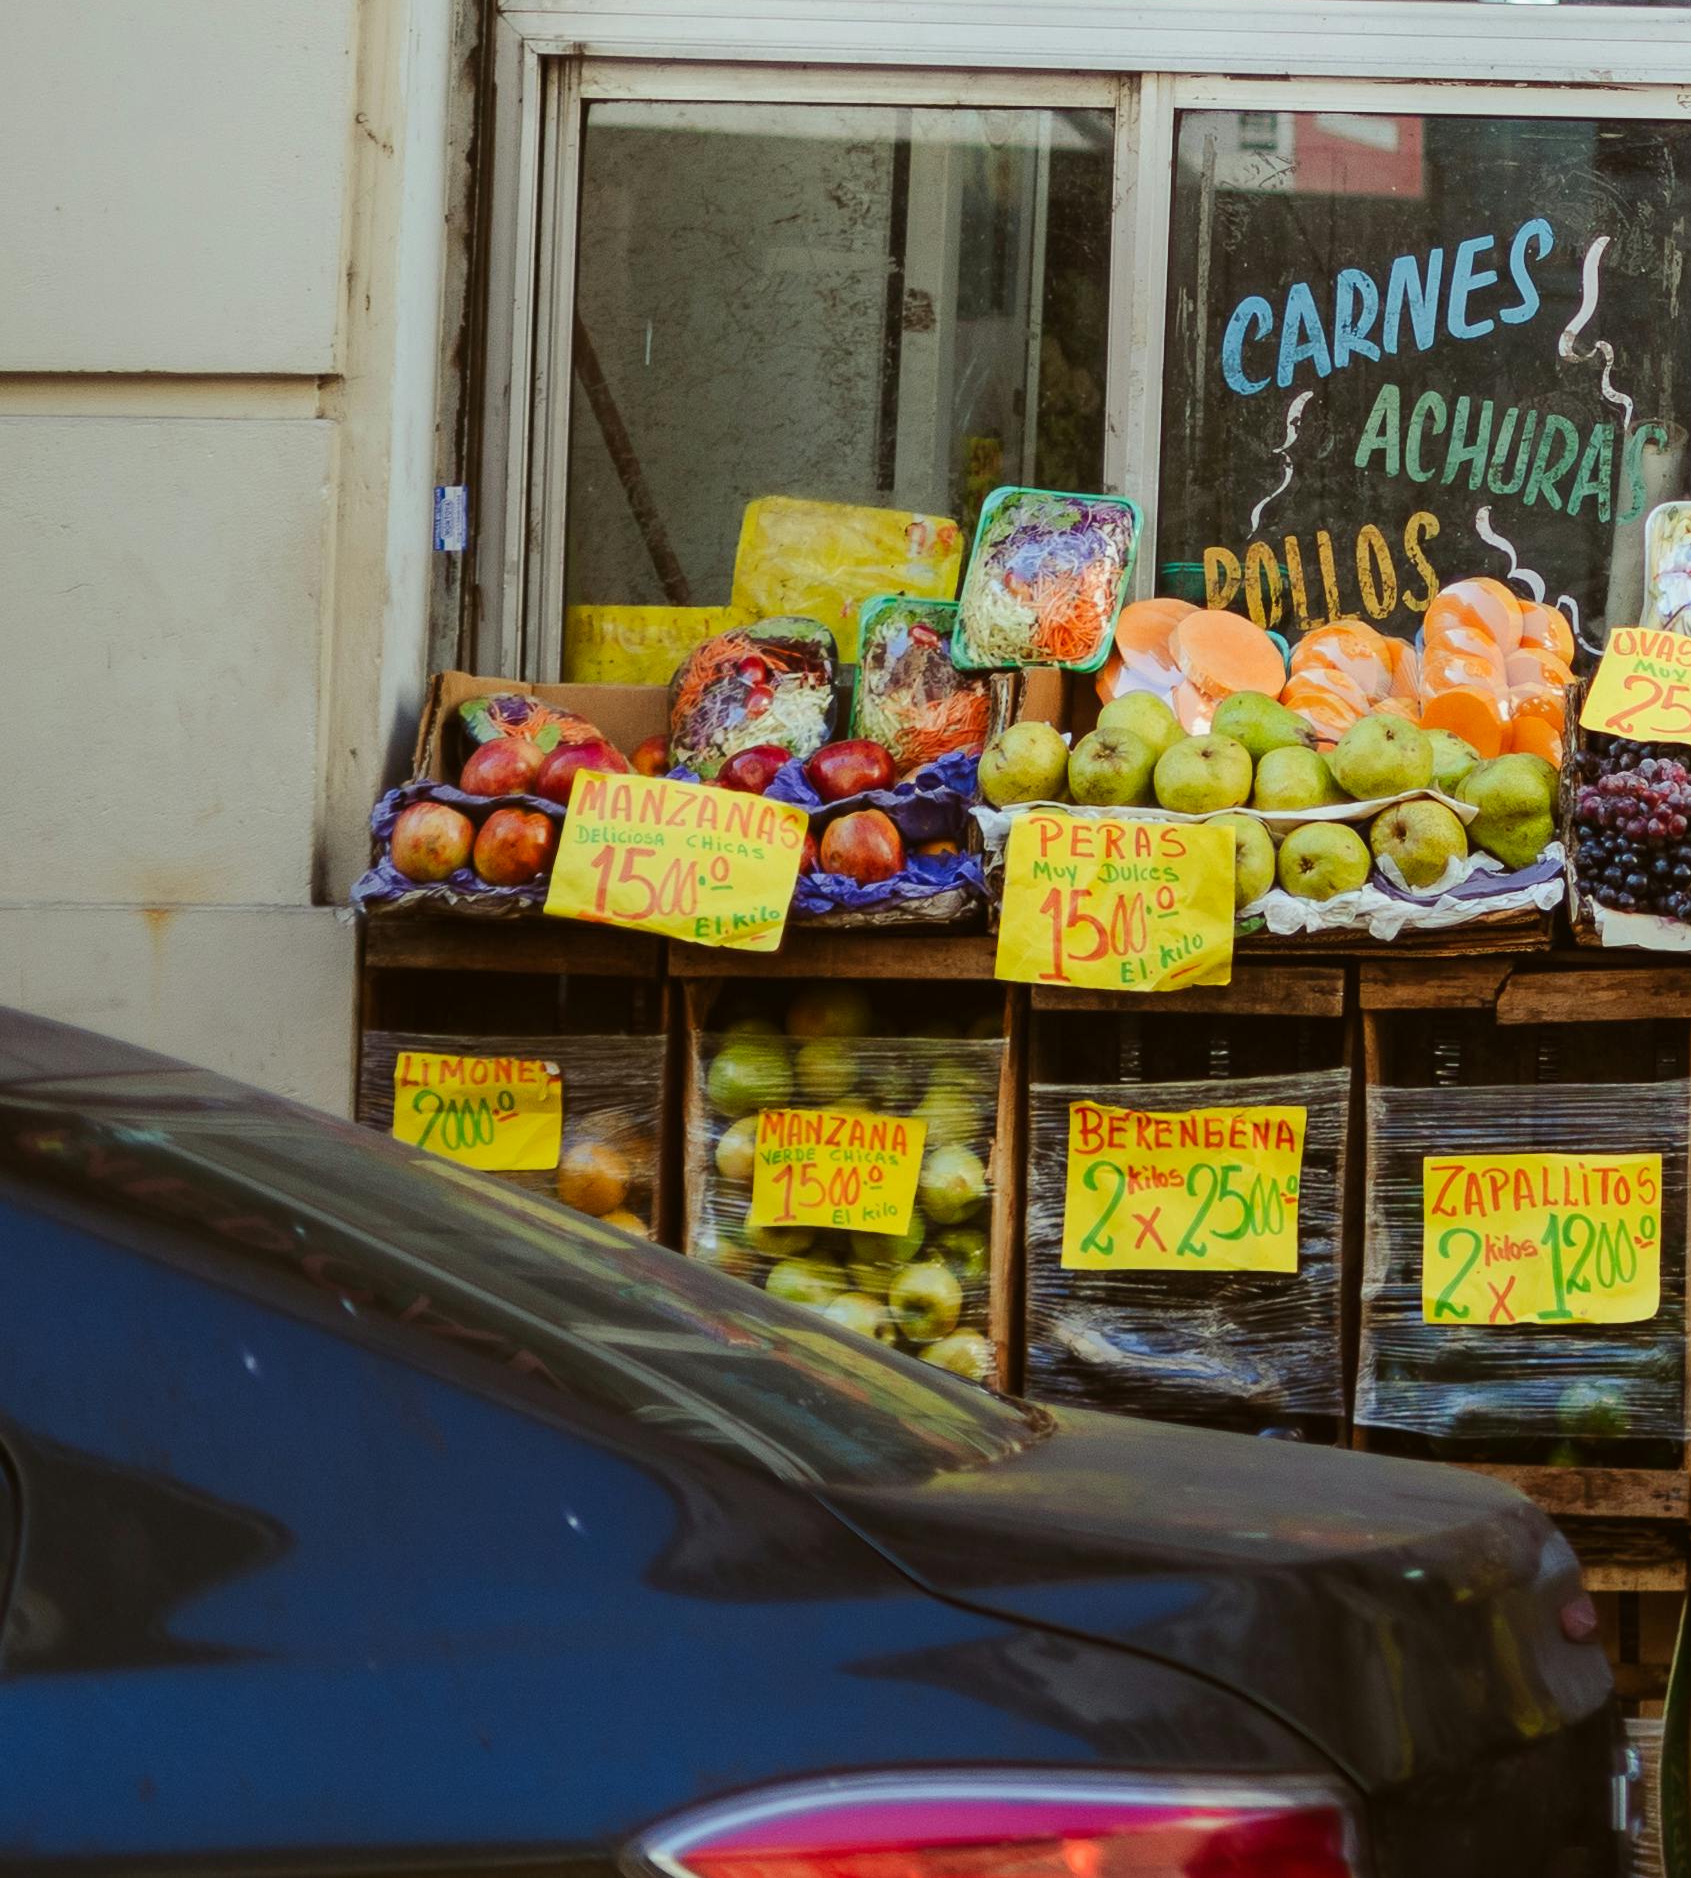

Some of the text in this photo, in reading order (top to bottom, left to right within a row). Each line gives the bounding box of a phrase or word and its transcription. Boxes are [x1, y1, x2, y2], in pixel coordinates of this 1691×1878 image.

[1221, 217, 1555, 395] CARNES
[1354, 383, 1669, 523] ACHURAS
[1203, 511, 1441, 631] POLLOS
[575, 778, 802, 850] MANZANAS
[1028, 817, 1187, 860] PERAS
[760, 1111, 908, 1157] MANZANA
[1079, 1160, 1126, 1257] 2
[1433, 1227, 1483, 1319] 2
